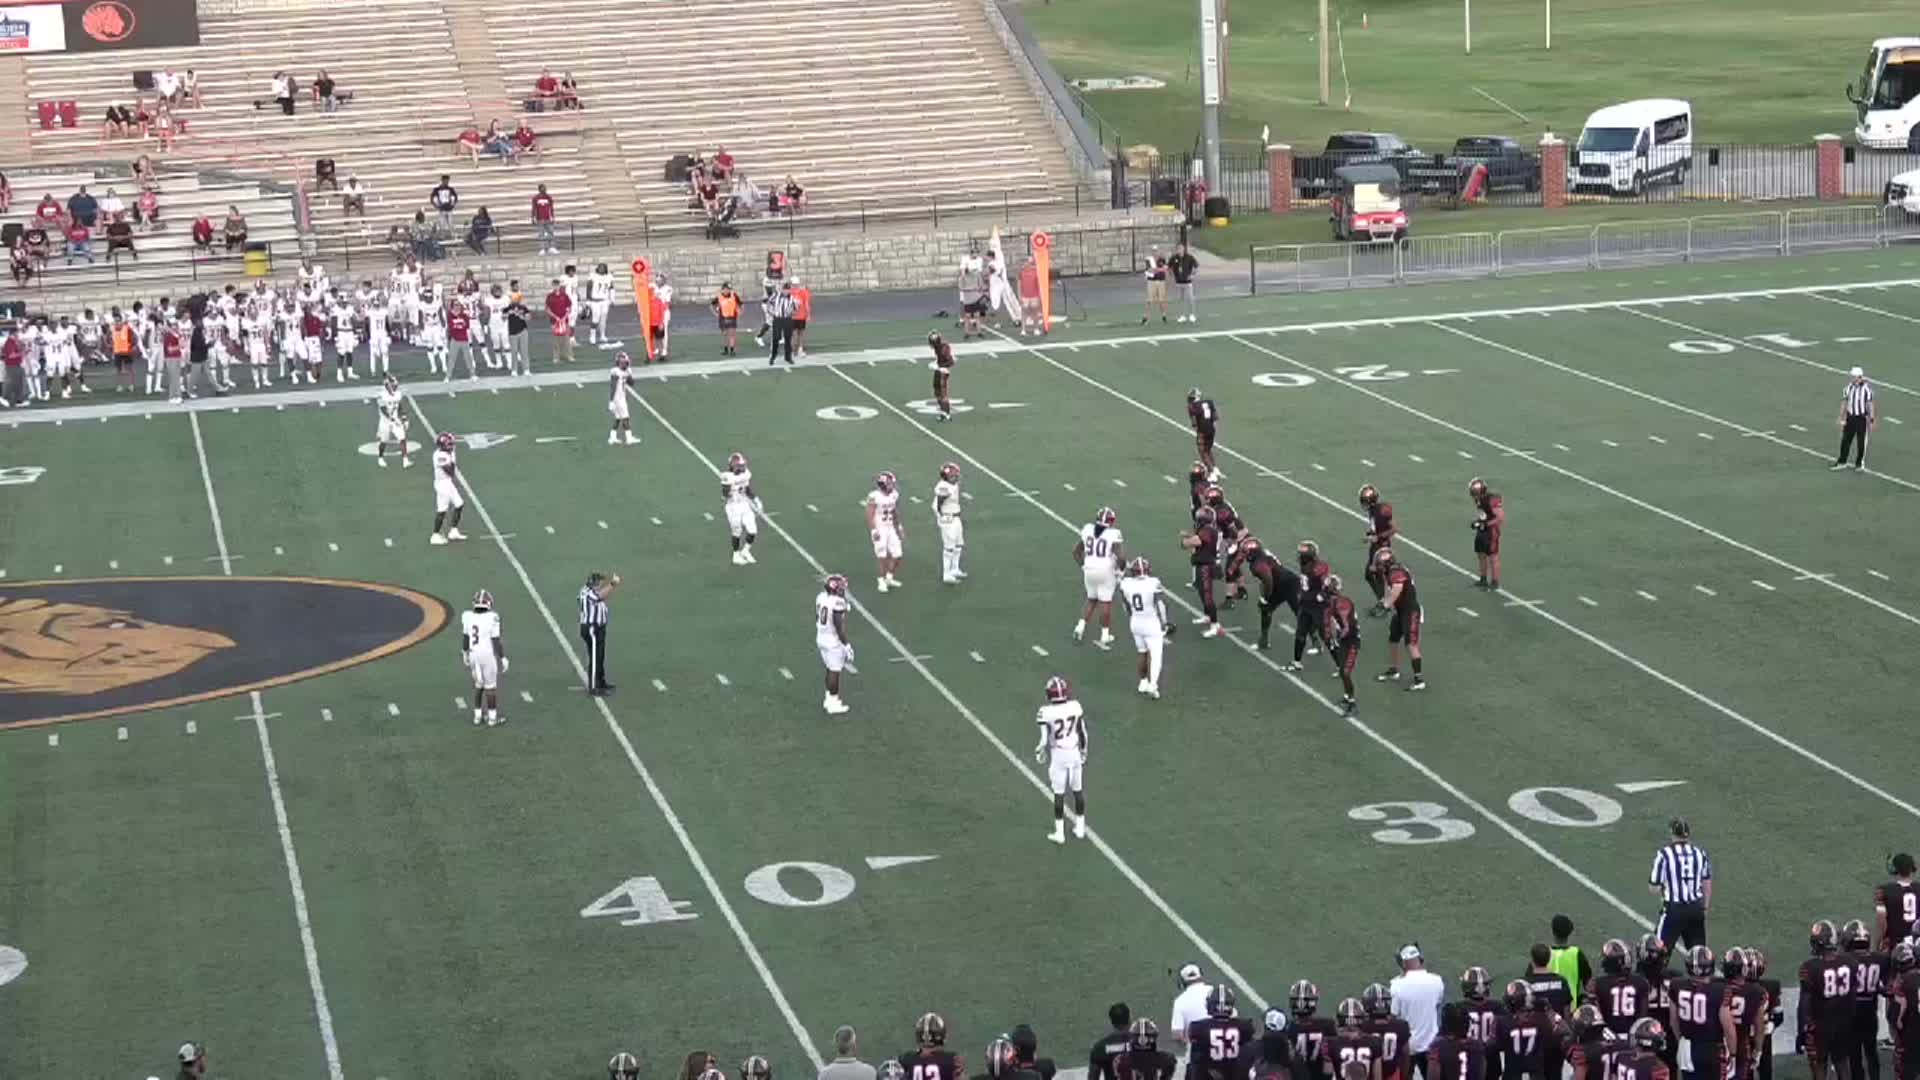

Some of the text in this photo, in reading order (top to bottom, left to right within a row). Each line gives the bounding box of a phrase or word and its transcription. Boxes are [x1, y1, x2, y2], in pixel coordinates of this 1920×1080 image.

[1086, 536, 1107, 557] 90
[1132, 593, 1144, 612] 0
[472, 624, 480, 646] 3
[1054, 715, 1076, 740] 27
[1902, 892, 1917, 922] 9
[1823, 965, 1851, 998] 83
[1610, 985, 1636, 1017] 16
[1677, 989, 1708, 1025] 50
[1209, 1028, 1241, 1061] 53
[1295, 1032, 1323, 1064] 47
[1509, 1027, 1538, 1056] 17
